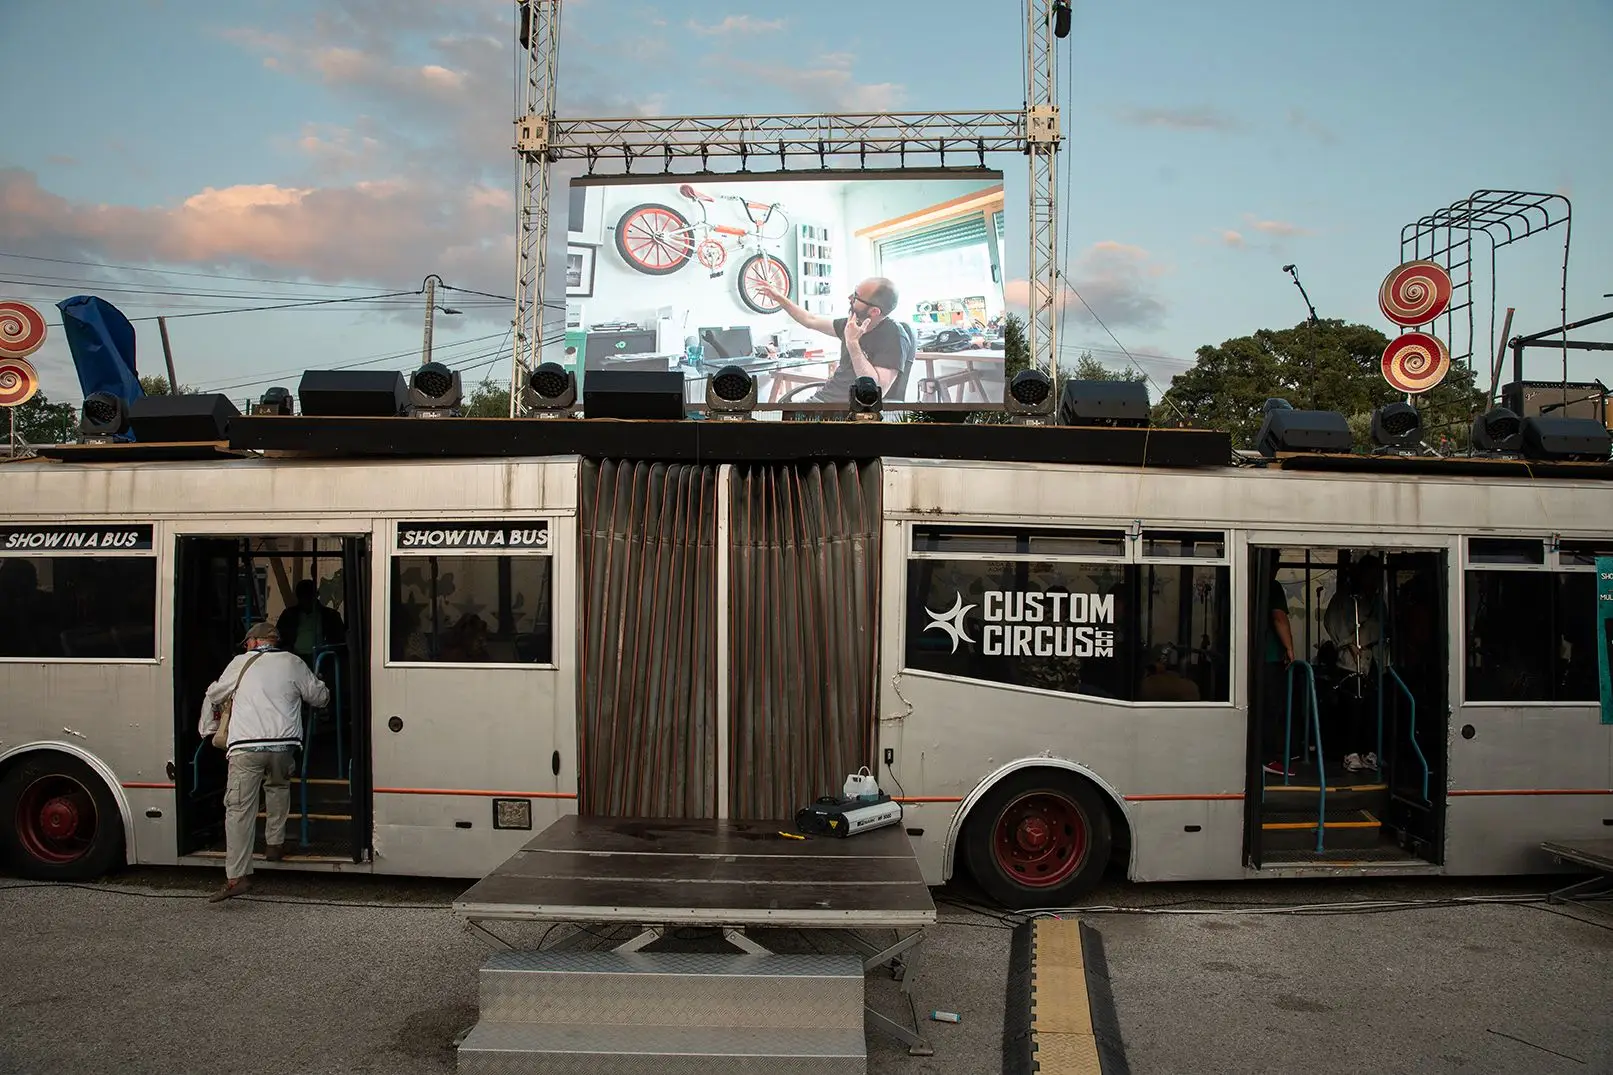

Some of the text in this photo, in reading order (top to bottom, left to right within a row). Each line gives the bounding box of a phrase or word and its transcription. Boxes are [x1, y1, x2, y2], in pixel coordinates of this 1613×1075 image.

[5, 532, 139, 548] SHOW IN A BUS
[402, 529, 548, 546] SHOW IN A BUS
[983, 590, 1115, 624] CUSTOM
[982, 625, 1094, 657] CIRCUS
